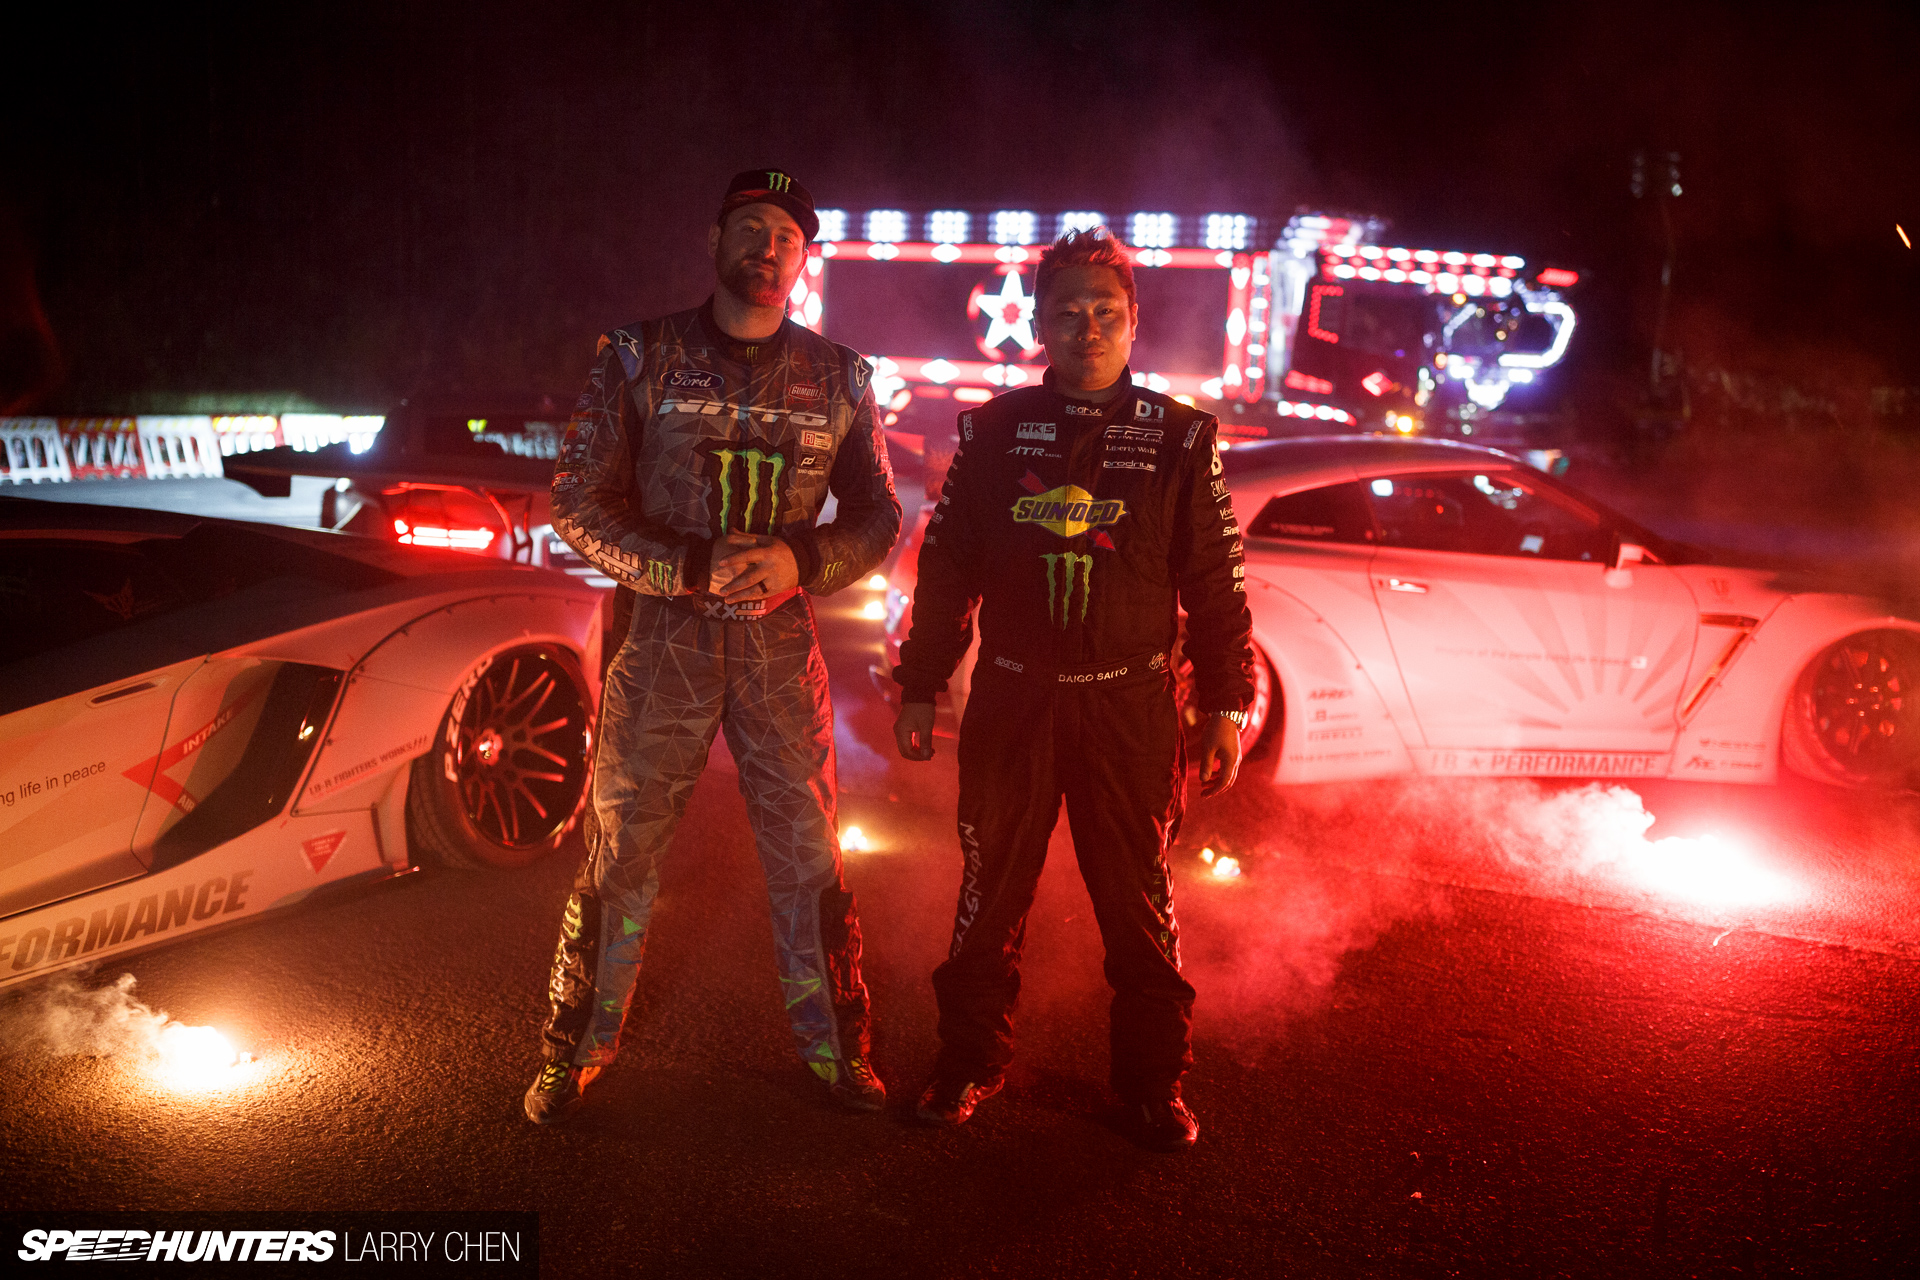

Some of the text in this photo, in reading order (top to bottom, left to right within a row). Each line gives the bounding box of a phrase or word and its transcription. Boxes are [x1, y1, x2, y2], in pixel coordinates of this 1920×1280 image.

[670, 370, 712, 388] Ford
[791, 385, 819, 397] GUMOUT
[1065, 404, 1103, 417] sparco
[1135, 399, 1165, 419] D1
[963, 413, 974, 441] sparco
[1017, 423, 1056, 437] HKS
[1183, 420, 1203, 449] sparco
[1105, 444, 1158, 456] Liberty Walk
[1135, 437, 1163, 445] RACING
[1006, 445, 1045, 457] ATR
[1103, 460, 1157, 471] prodrive
[1016, 499, 1121, 524] SUNOCO
[994, 656, 1024, 673] sparco
[1058, 667, 1128, 683] DAIGO SAITO
[446, 656, 494, 748] ZERO
[182, 706, 236, 756] INTAKE
[334, 757, 378, 785] FIGHTERS
[1490, 753, 1656, 774] PERFORMANCE
[19, 779, 42, 800] life
[45, 775, 59, 791] in
[63, 760, 107, 786] peace
[177, 795, 196, 813] AIR
